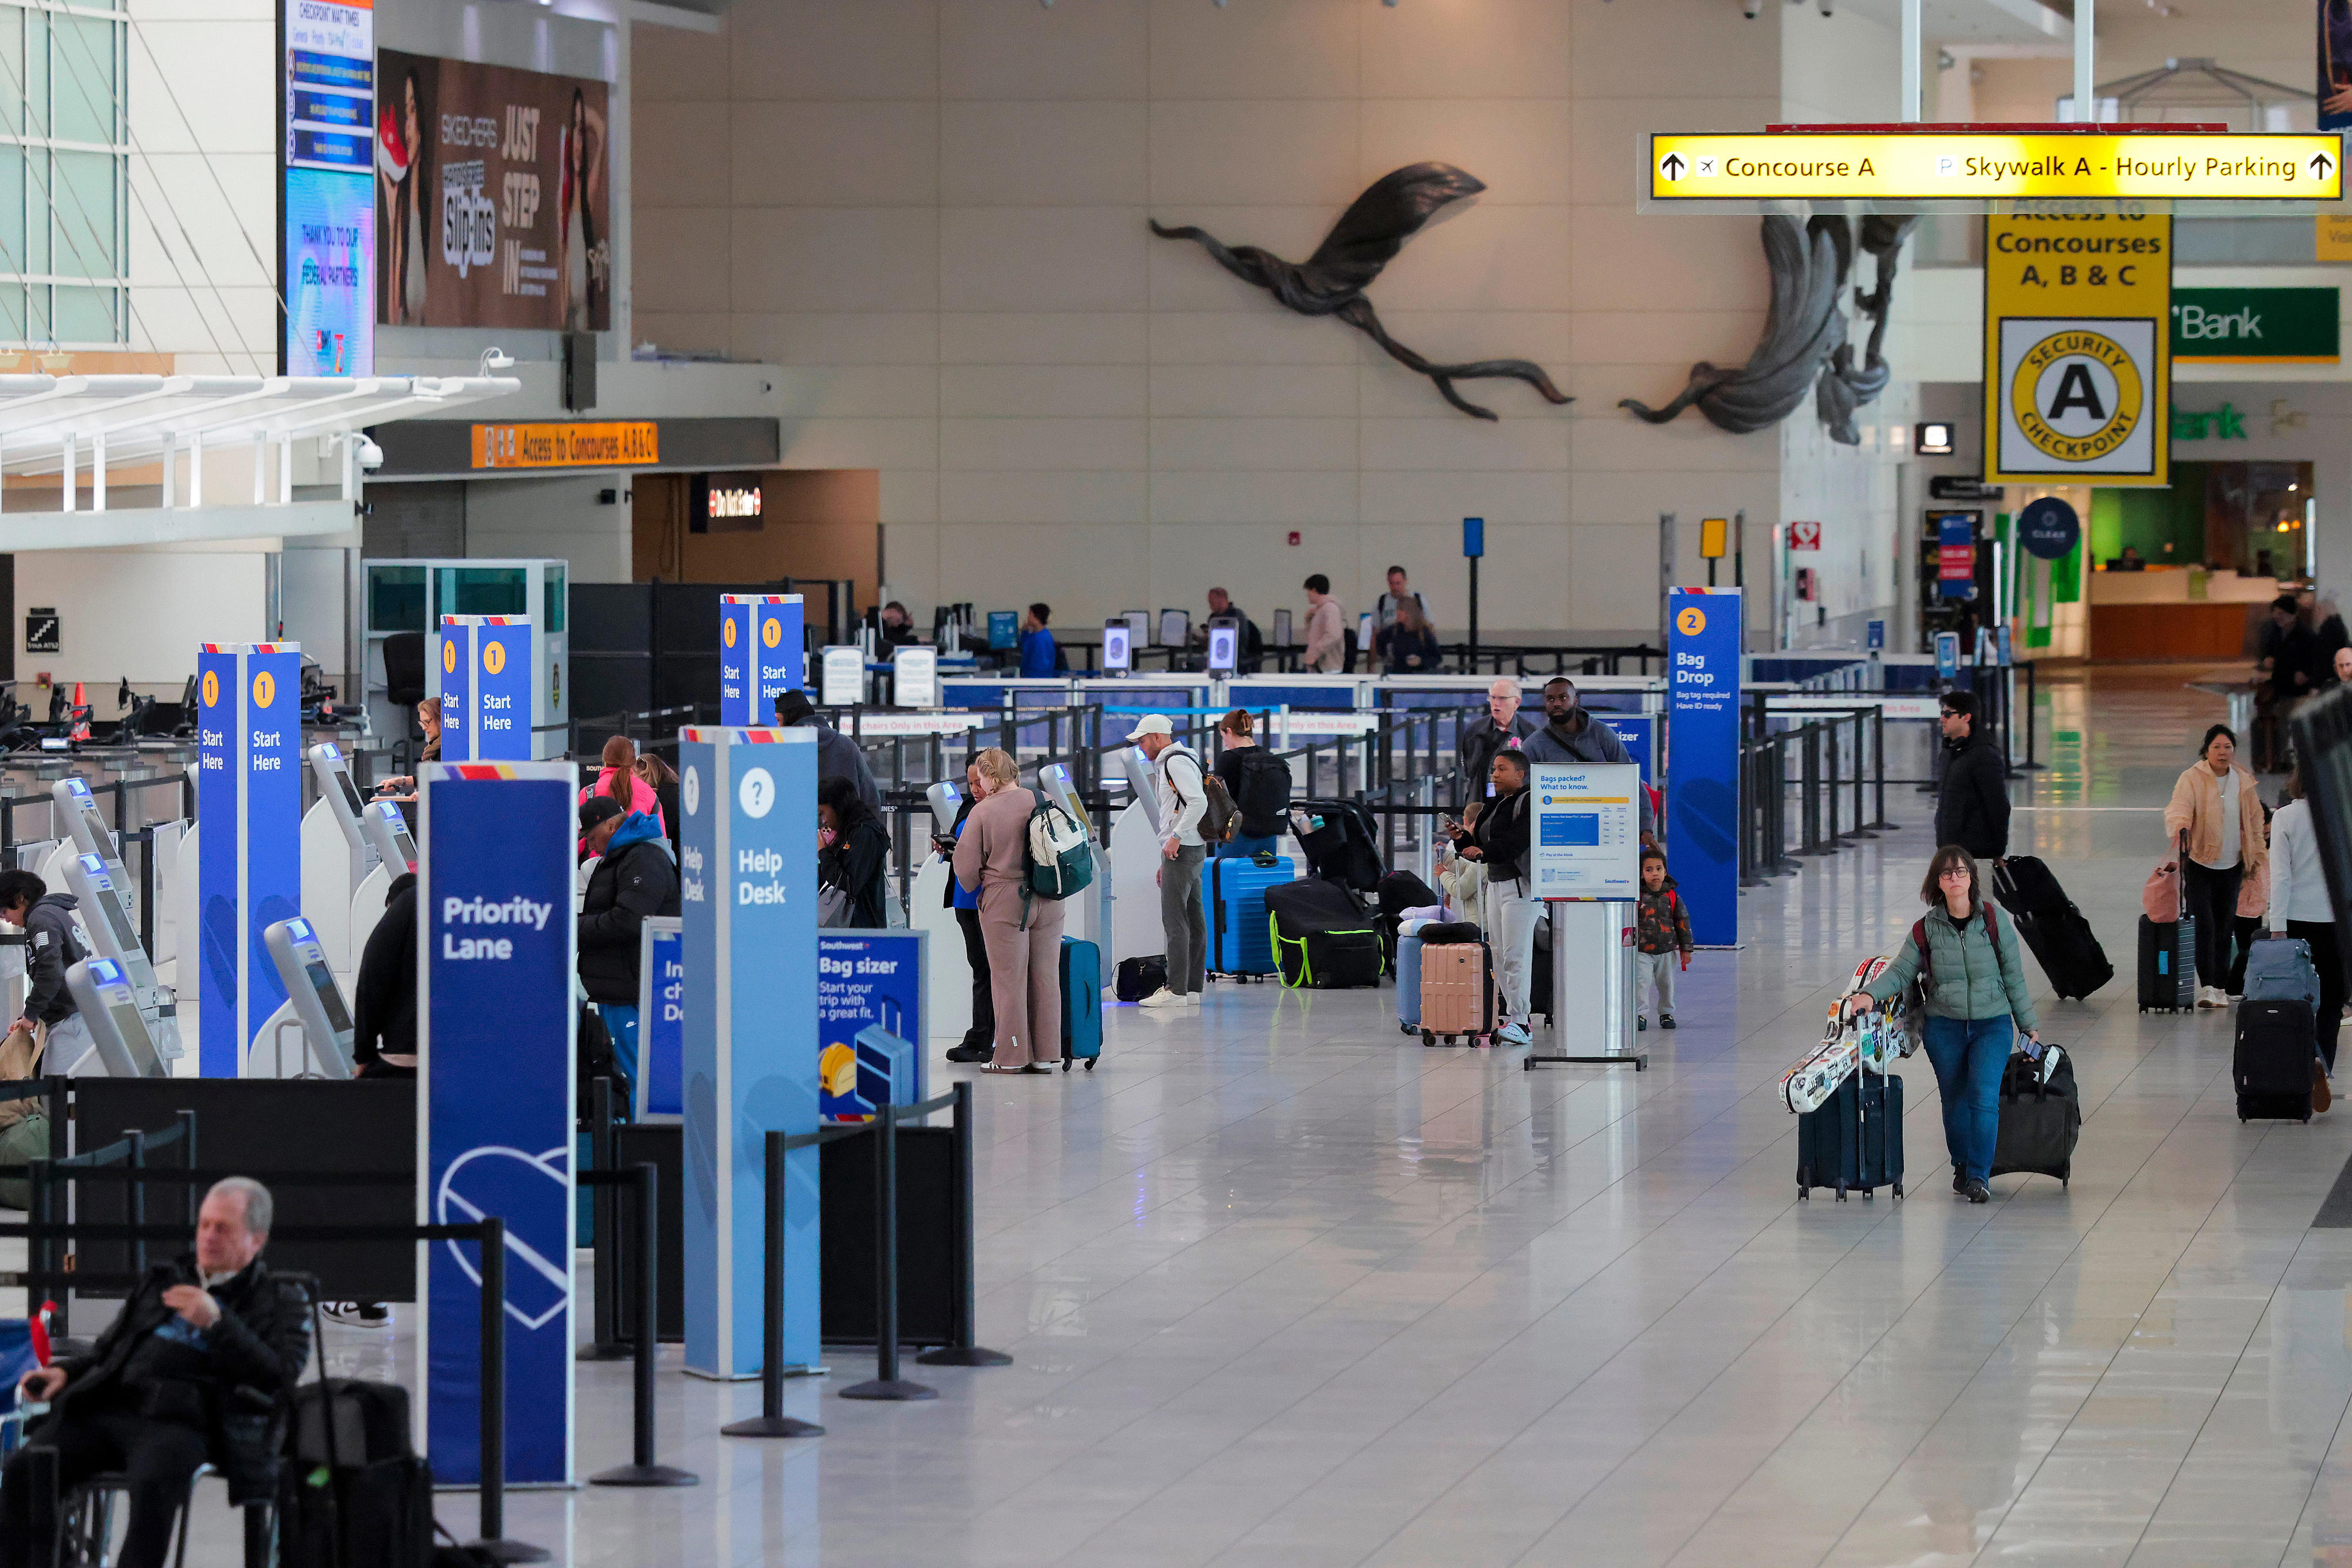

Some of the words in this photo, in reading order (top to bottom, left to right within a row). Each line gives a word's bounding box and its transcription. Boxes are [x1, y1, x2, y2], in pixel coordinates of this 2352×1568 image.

[300, 2, 330, 21] CHECKPOINT
[345, 9, 359, 27] TIMES
[502, 104, 540, 162] JUST
[1726, 158, 1849, 177] Concourse
[1857, 158, 1876, 177] A
[1966, 156, 2066, 181] Skywalk
[2074, 157, 2091, 176] A
[2116, 157, 2197, 181] Hourly
[2206, 157, 2296, 181] Parking
[502, 171, 541, 229] STEP
[2012, 199, 2105, 221] Access
[2117, 200, 2146, 221] to
[302, 224, 323, 244] THANK
[324, 225, 336, 246] YOU
[337, 227, 344, 247] TO
[346, 227, 358, 247] OUR
[447, 196, 495, 265] Slip-ins
[1996, 232, 2162, 254] Concourses
[302, 265, 327, 286] FEDERAL
[503, 239, 520, 295] IN
[2020, 266, 2047, 288] A,
[2060, 266, 2077, 287] B
[2088, 266, 2108, 287] &
[2118, 265, 2137, 287] C
[2172, 305, 2263, 339] Bank
[2029, 337, 2127, 370] SECURITY
[2048, 363, 2106, 420] A
[2172, 402, 2248, 440] ank
[2021, 411, 2135, 457] CHECKPOINT
[523, 429, 551, 461] Access
[557, 432, 566, 461] to
[570, 429, 618, 461] Concourses
[1687, 614, 1697, 628] 2
[728, 626, 731, 640] 1
[769, 626, 774, 640] 1
[448, 648, 451, 665] 1
[491, 650, 496, 666] 1
[1677, 652, 1705, 670] Bag
[724, 665, 740, 680] Start
[762, 665, 787, 680] Start
[1677, 670, 1715, 687] Drop
[208, 680, 212, 698] 1
[261, 681, 266, 699] 1
[724, 684, 740, 699] Here
[763, 684, 787, 698] Here
[1676, 691, 1690, 700] Bag
[444, 692, 459, 709] Start
[484, 694, 512, 710] Start
[1703, 703, 1722, 711] ready
[444, 713, 460, 729] Here
[484, 715, 512, 730] Here
[891, 722, 911, 731] Only
[1288, 721, 1304, 731] nly
[202, 729, 224, 747] Start
[253, 731, 281, 748] Start
[1617, 731, 1639, 741] izer
[203, 752, 224, 770] Here
[253, 754, 281, 771] Here
[752, 781, 763, 806] ?
[683, 845, 703, 876] Help
[739, 847, 783, 879] Help
[684, 877, 705, 902] Desk
[739, 880, 786, 905] Desk
[443, 895, 553, 931] Priority
[443, 932, 513, 960] Lane
[820, 940, 864, 950] Southwest
[820, 956, 853, 978] Bag
[856, 956, 898, 974] sizer
[819, 980, 845, 993] Start
[846, 983, 873, 996] your
[818, 994, 839, 1008] trip
[840, 994, 865, 1006] with
[818, 1009, 826, 1018] a
[827, 1008, 858, 1022] great
[859, 1007, 874, 1019] fit.
